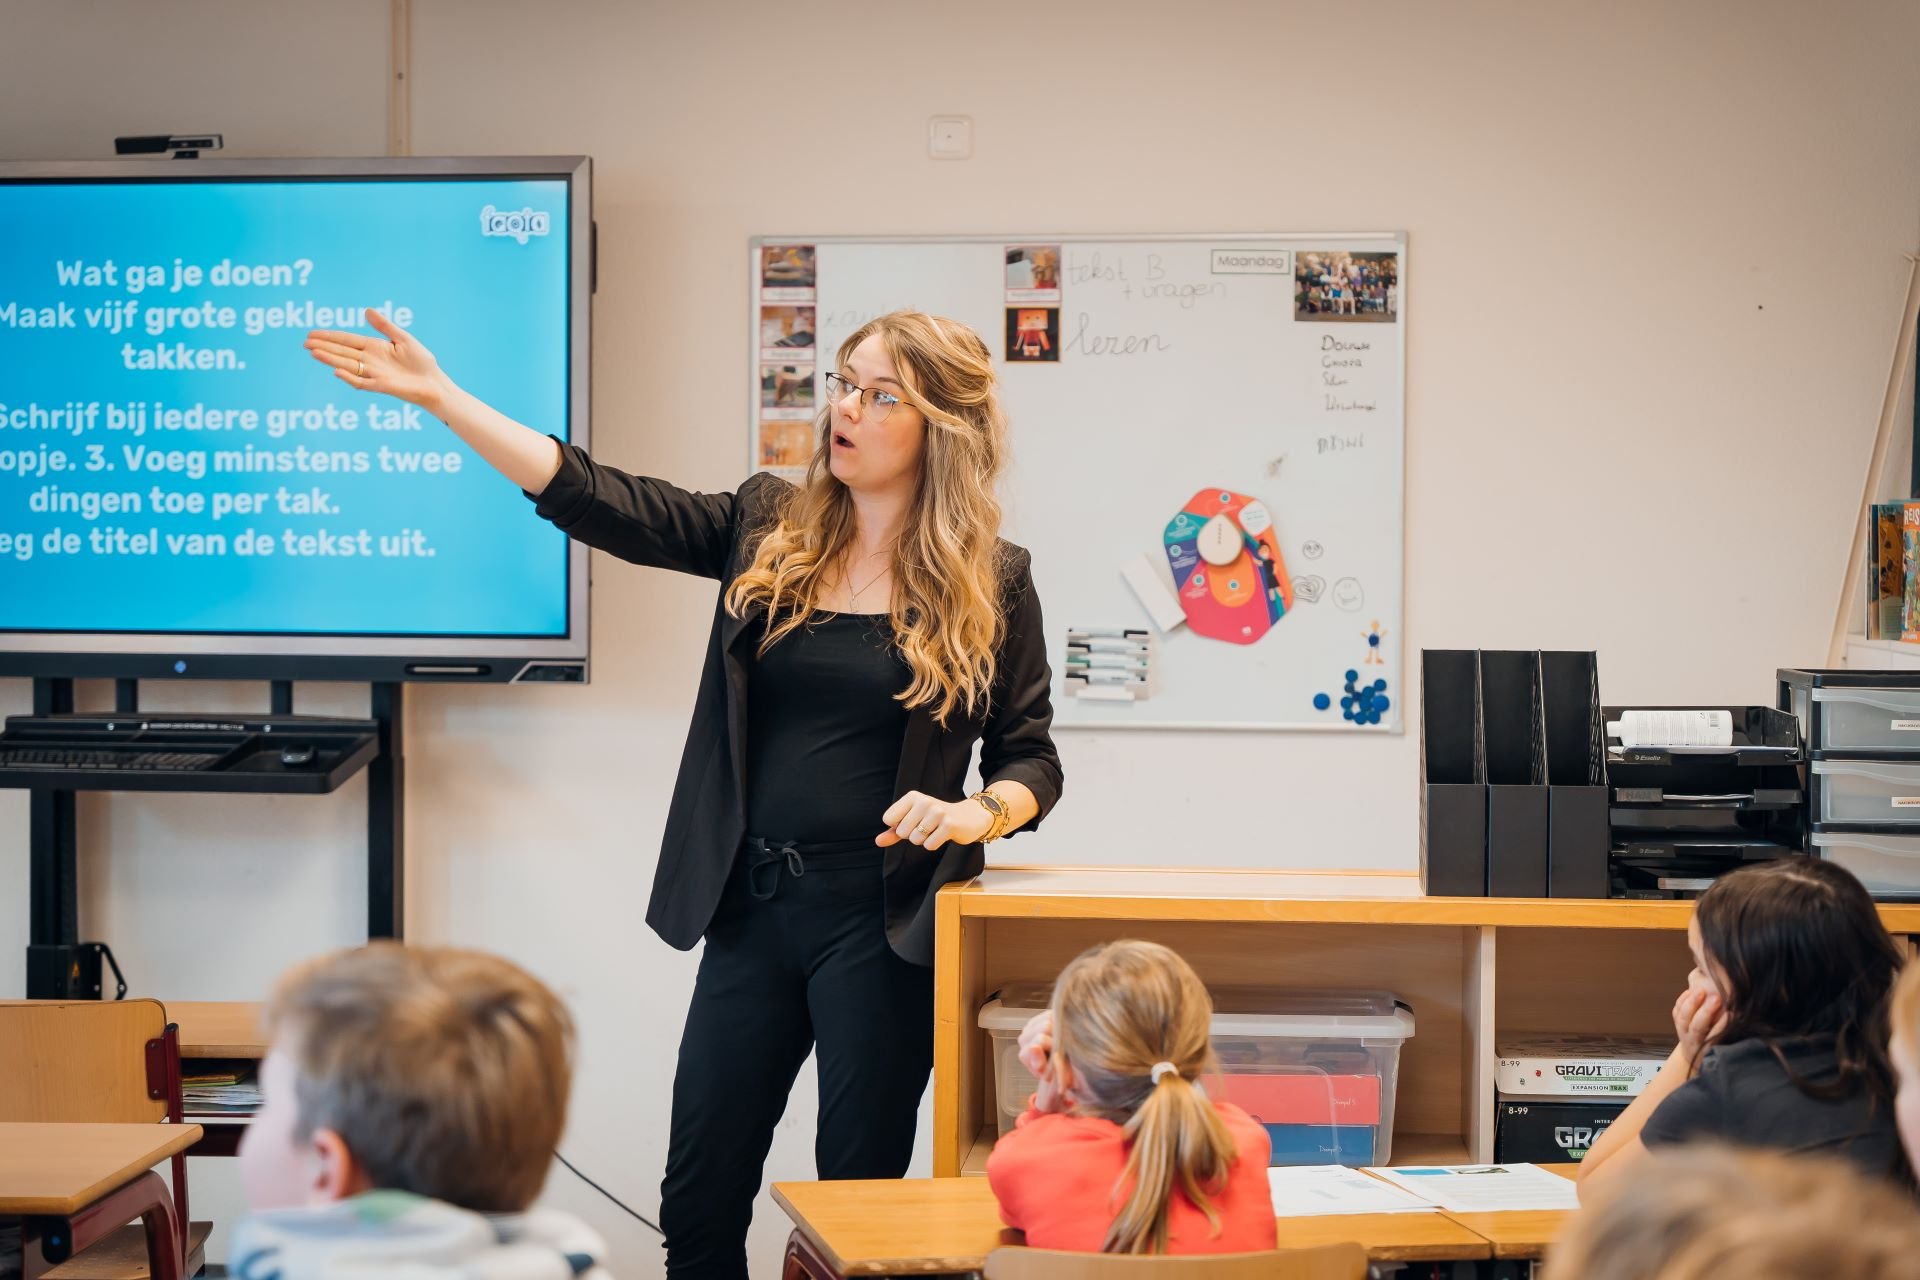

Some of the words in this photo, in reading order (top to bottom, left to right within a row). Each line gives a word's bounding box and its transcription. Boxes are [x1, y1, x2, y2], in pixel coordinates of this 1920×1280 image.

[56, 259, 118, 286] Wat
[126, 265, 165, 294] ga
[170, 258, 203, 293] je
[210, 258, 314, 286] doen?
[1217, 255, 1284, 269] Maandag
[0, 301, 76, 328] Maak
[84, 300, 138, 335] vijf
[145, 301, 236, 336] grote
[121, 342, 246, 370] takken.
[106, 402, 146, 436] bij
[154, 402, 259, 430] iedere
[266, 403, 359, 438] grote
[366, 403, 422, 431] tak
[84, 444, 115, 471] 3.
[122, 444, 206, 479] Voeg
[214, 443, 370, 472] minstens
[377, 445, 462, 472] twee
[29, 485, 142, 520] dingen
[149, 486, 204, 513] toe
[212, 491, 269, 520] per
[275, 487, 340, 514] tak.
[42, 527, 81, 554] de
[89, 526, 157, 555] titel
[165, 533, 226, 556] van
[234, 527, 275, 556] de
[282, 528, 372, 556] tekst
[379, 528, 436, 557] uit.
[1508, 1107, 1529, 1115] 8-99
